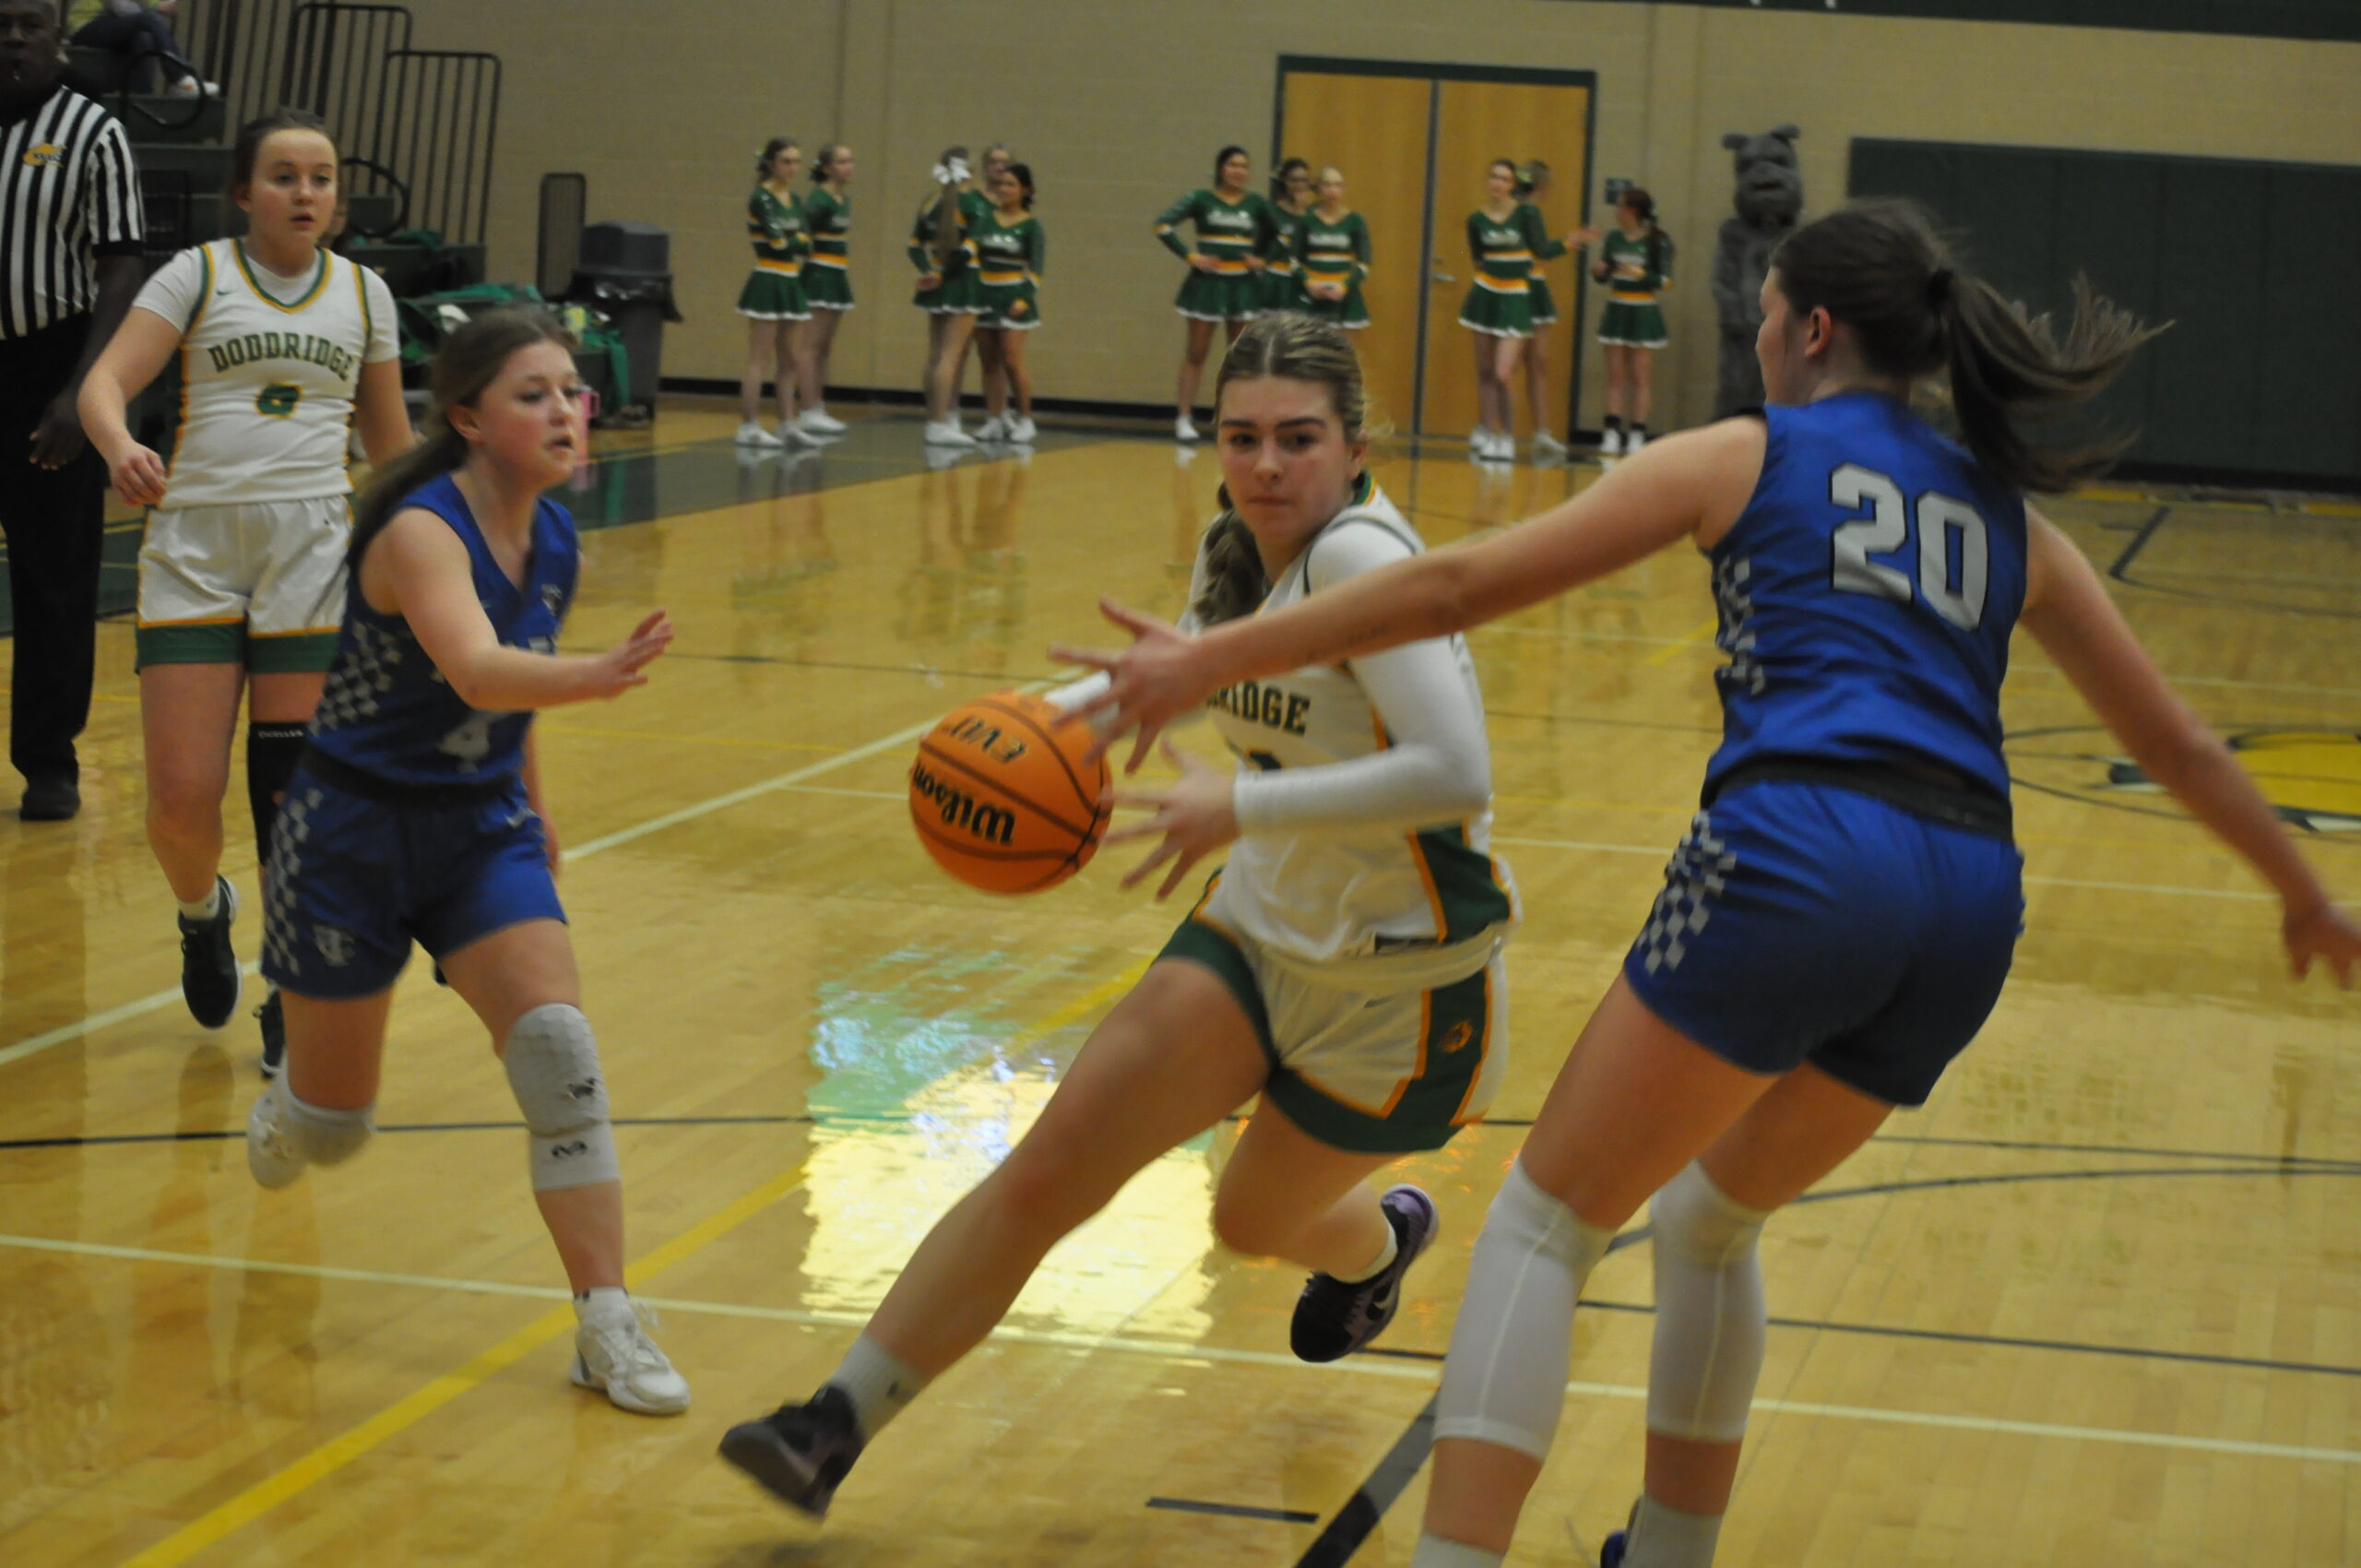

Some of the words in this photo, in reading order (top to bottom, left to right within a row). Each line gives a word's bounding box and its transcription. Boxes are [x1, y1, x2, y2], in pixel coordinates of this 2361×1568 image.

[207, 331, 354, 382] DODDRIDGE
[1828, 460, 1989, 633] 20
[911, 761, 1015, 845] Wilson
